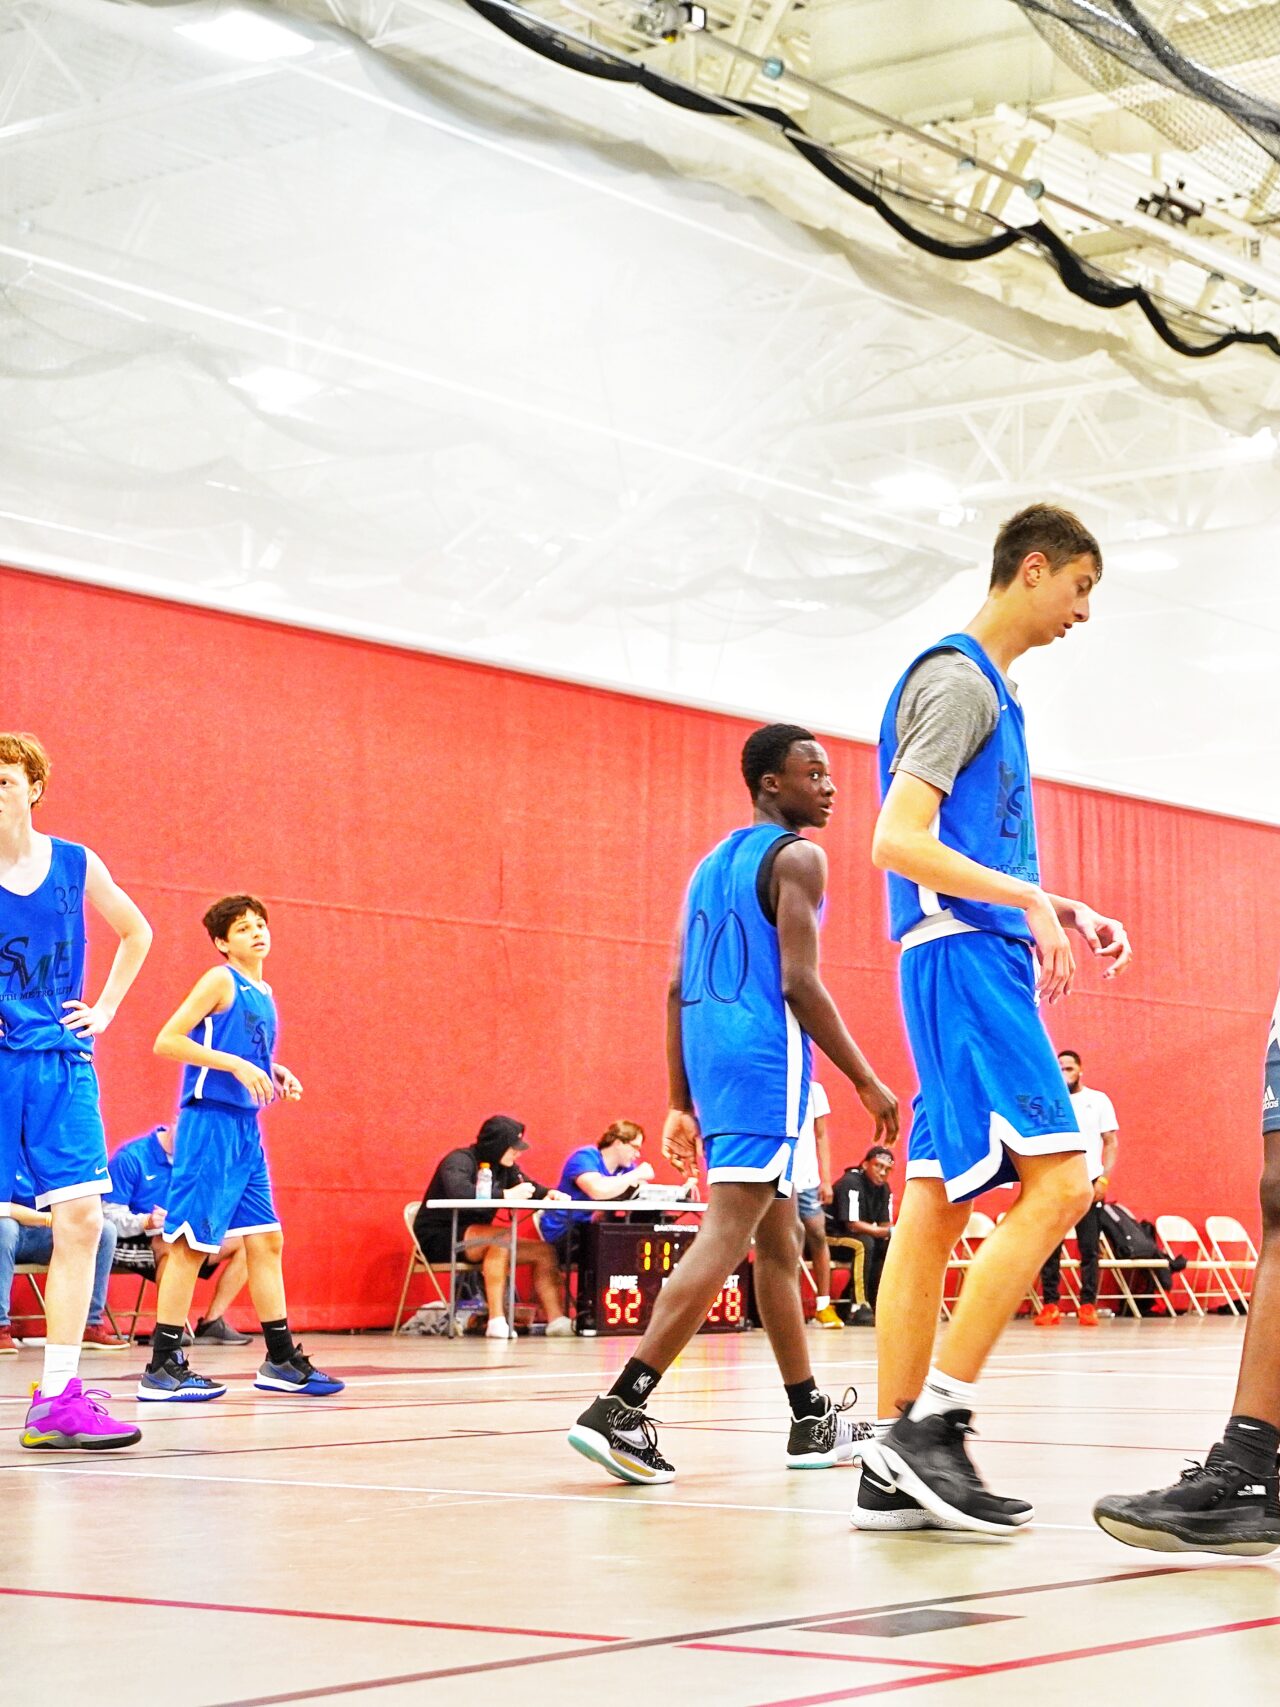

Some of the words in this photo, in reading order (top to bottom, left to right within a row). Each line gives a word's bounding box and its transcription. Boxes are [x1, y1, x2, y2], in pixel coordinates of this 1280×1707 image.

[54, 885, 79, 916] 32
[680, 909, 748, 1007] 20
[605, 1288, 641, 1324] 52
